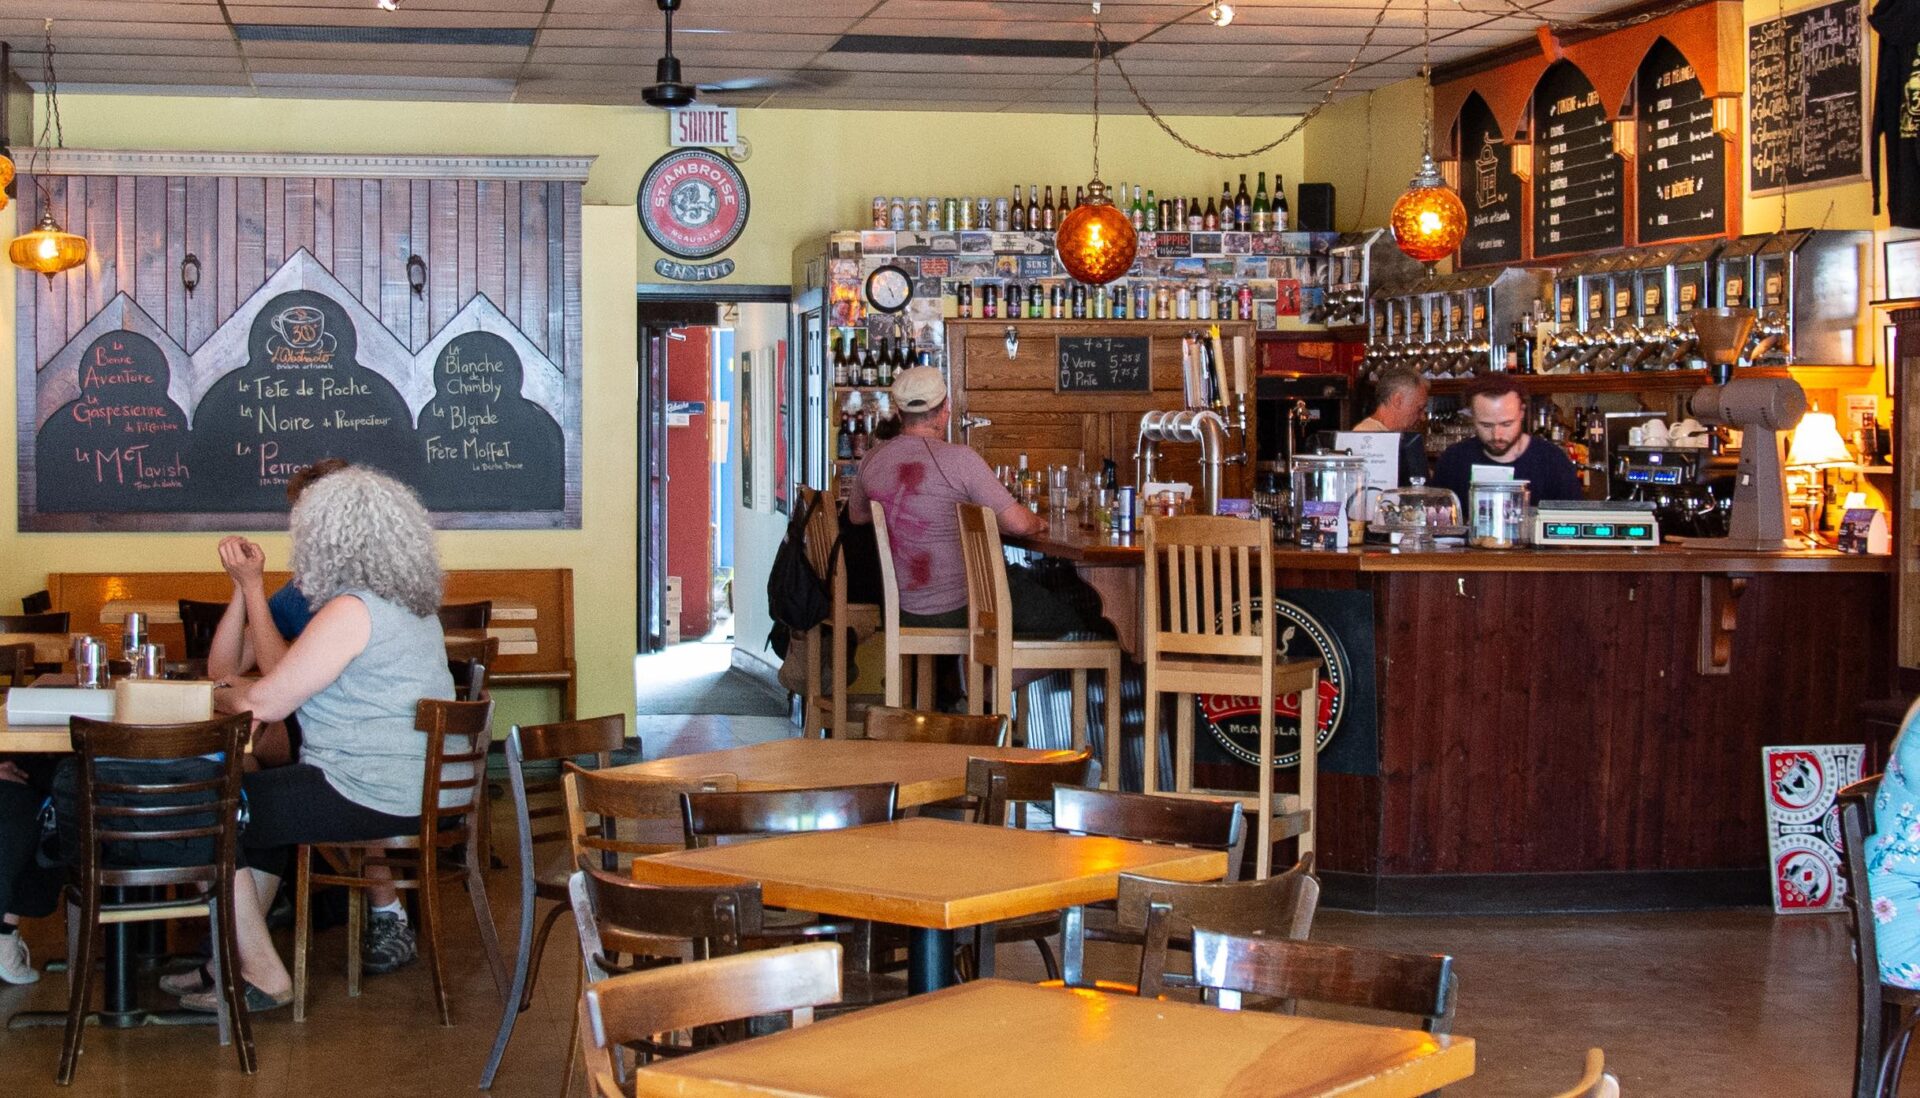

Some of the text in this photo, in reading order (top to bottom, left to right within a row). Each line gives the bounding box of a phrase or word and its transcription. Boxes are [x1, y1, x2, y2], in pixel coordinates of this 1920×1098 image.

[679, 111, 729, 143] SORTIE
[655, 163, 735, 208] ST-AMBROISE
[1157, 234, 1190, 246] HIPPIES
[661, 262, 686, 279] EN
[1084, 338, 1094, 352] 4
[1104, 338, 1112, 352] 7
[95, 346, 136, 367] Bonne
[445, 353, 505, 375] Blanche
[1072, 357, 1097, 369] Verre
[84, 366, 154, 389] Aventure
[469, 373, 480, 381] de
[1075, 371, 1099, 387] Pinte
[296, 379, 314, 396] de
[321, 377, 372, 400] Pioche
[447, 377, 502, 402] Chambly
[258, 405, 315, 434] Noire
[334, 409, 392, 431] Prospecteur
[450, 405, 499, 430] Blonde
[1230, 724, 1302, 736] McASLA
